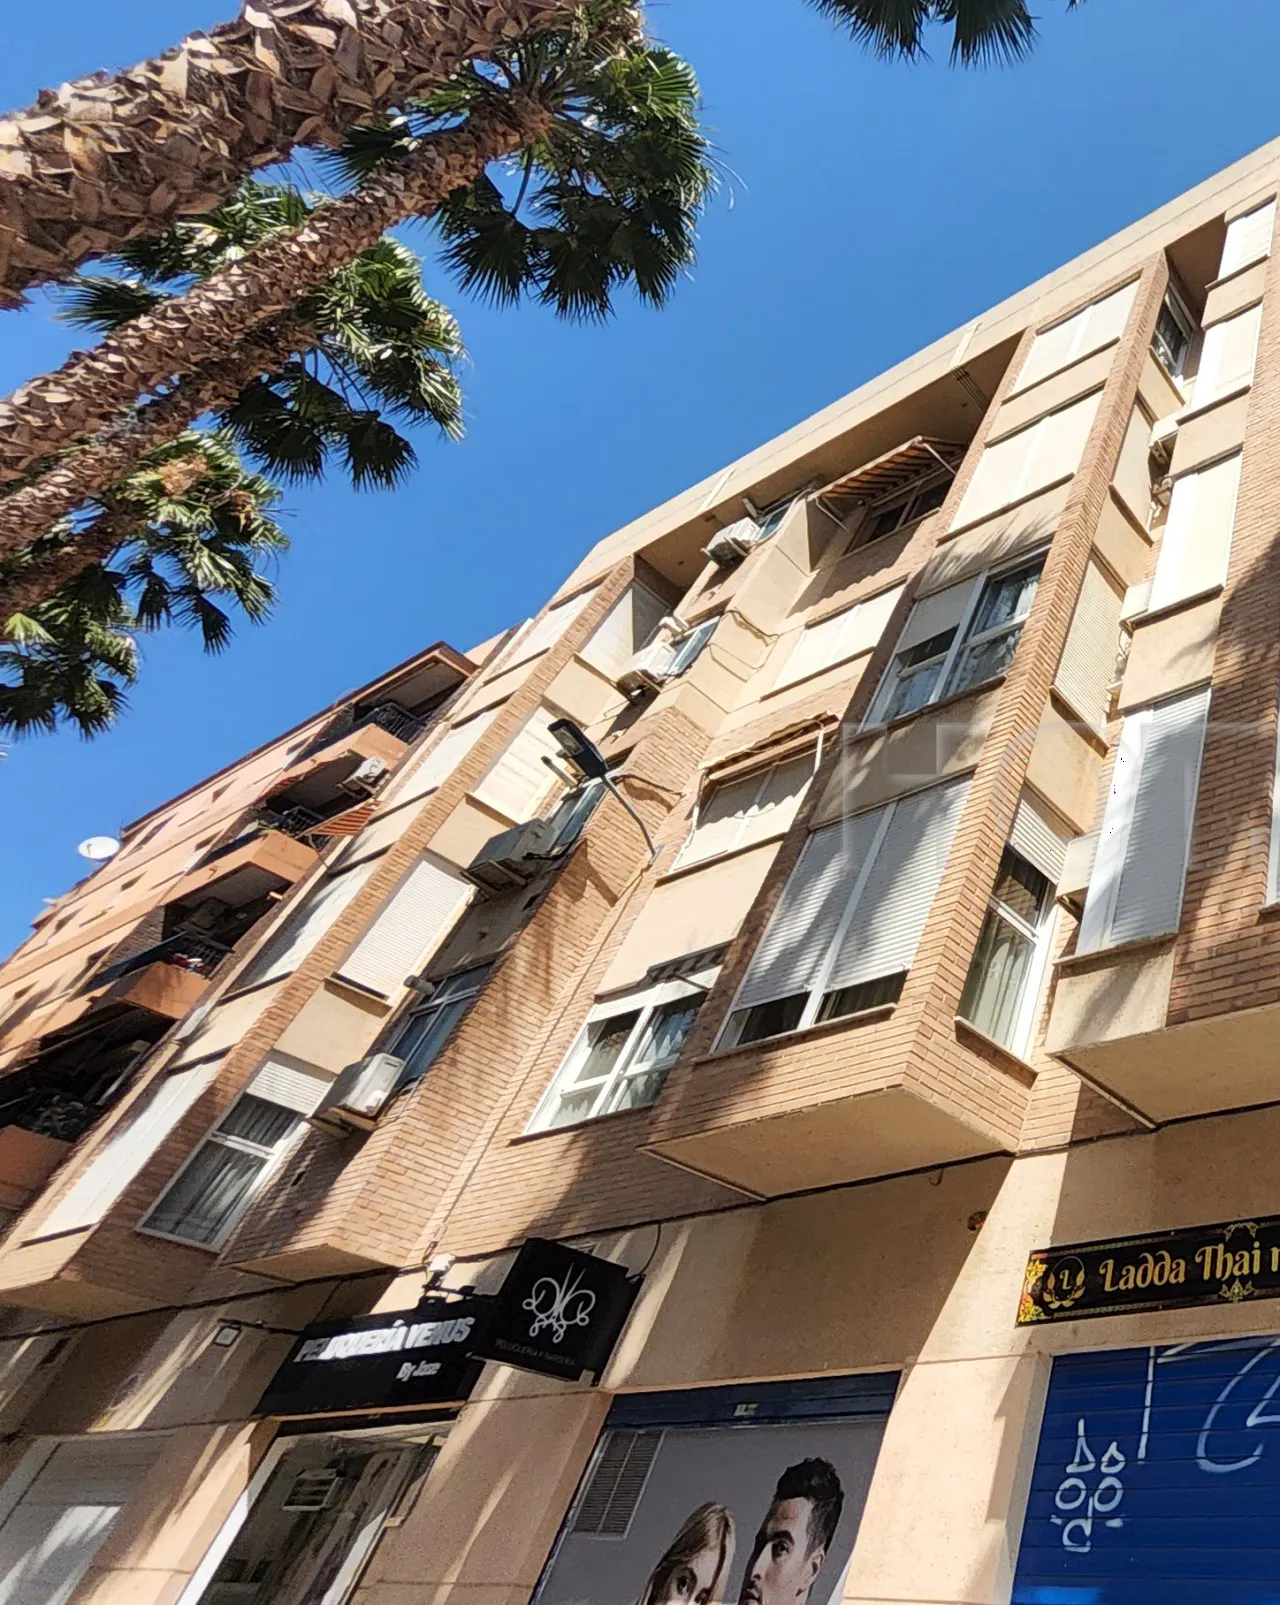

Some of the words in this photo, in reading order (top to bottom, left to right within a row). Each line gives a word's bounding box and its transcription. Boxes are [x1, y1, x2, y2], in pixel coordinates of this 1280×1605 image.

[1099, 1250, 1187, 1293] Ladda
[1195, 1241, 1260, 1282] Thai
[404, 1317, 475, 1350] VENUS
